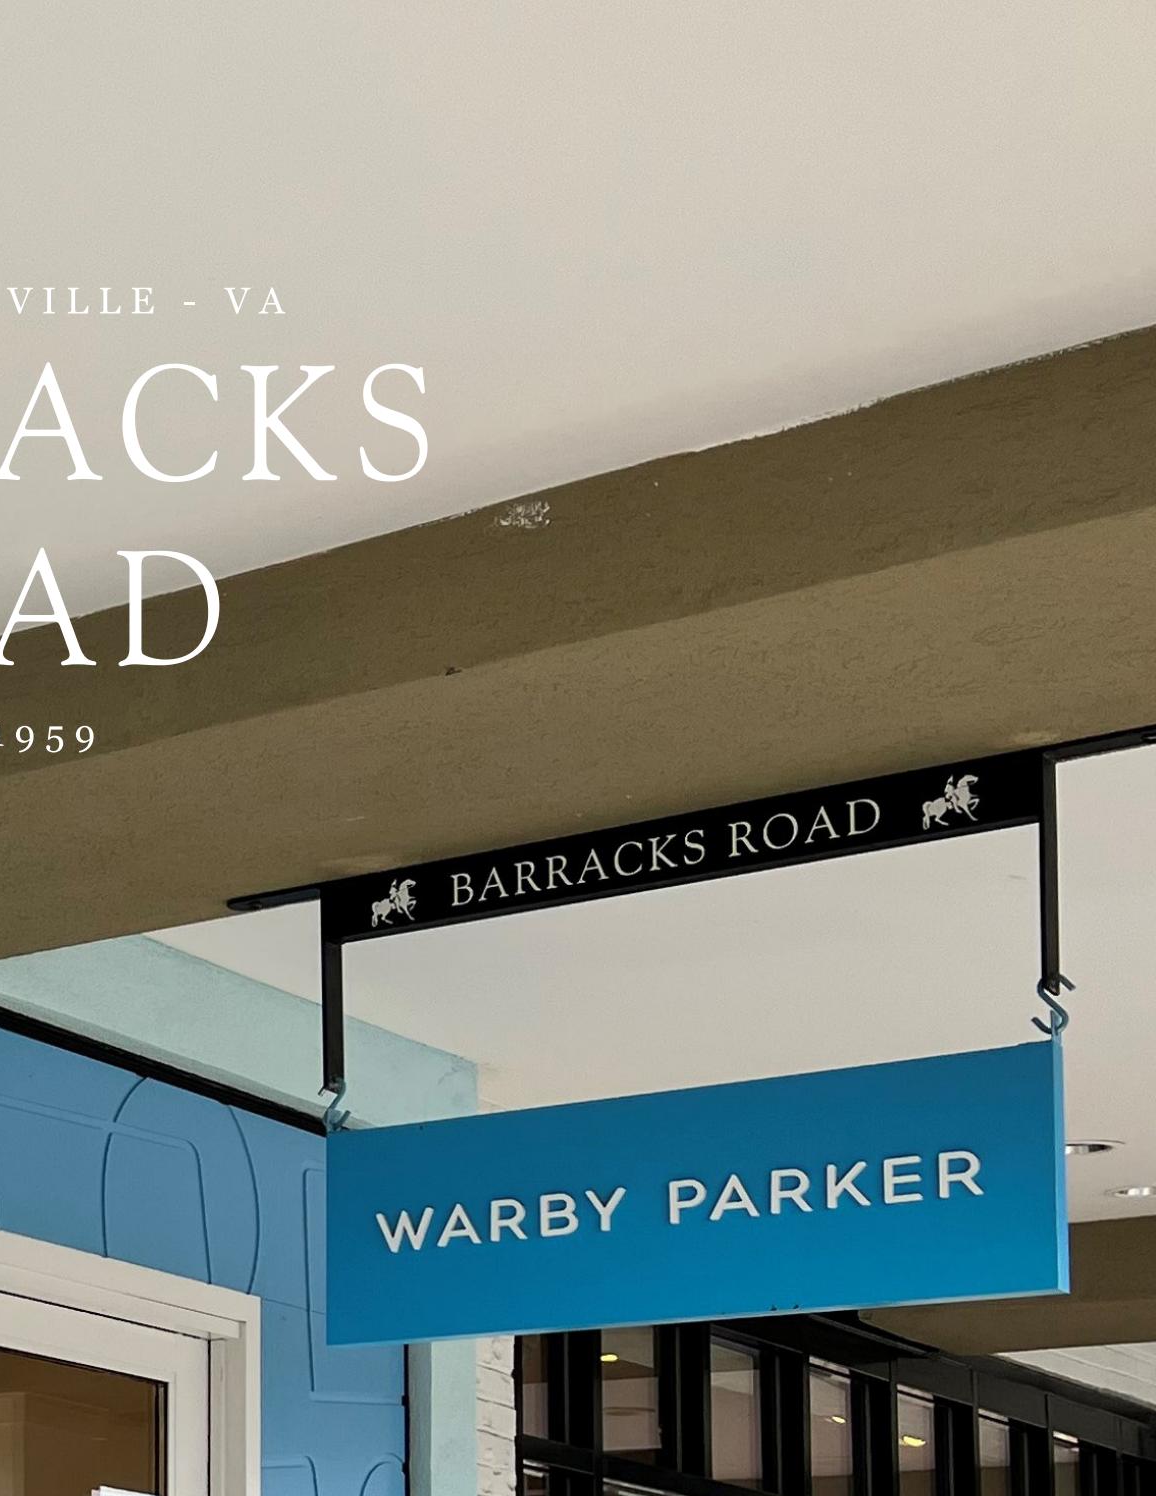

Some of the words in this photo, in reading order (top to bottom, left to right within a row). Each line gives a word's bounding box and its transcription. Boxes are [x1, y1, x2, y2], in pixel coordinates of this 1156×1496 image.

[451, 829, 707, 906] BARRACKS
[728, 798, 882, 859] ROAD
[376, 1187, 626, 1253] WARBY
[669, 1150, 984, 1224] PARKER
